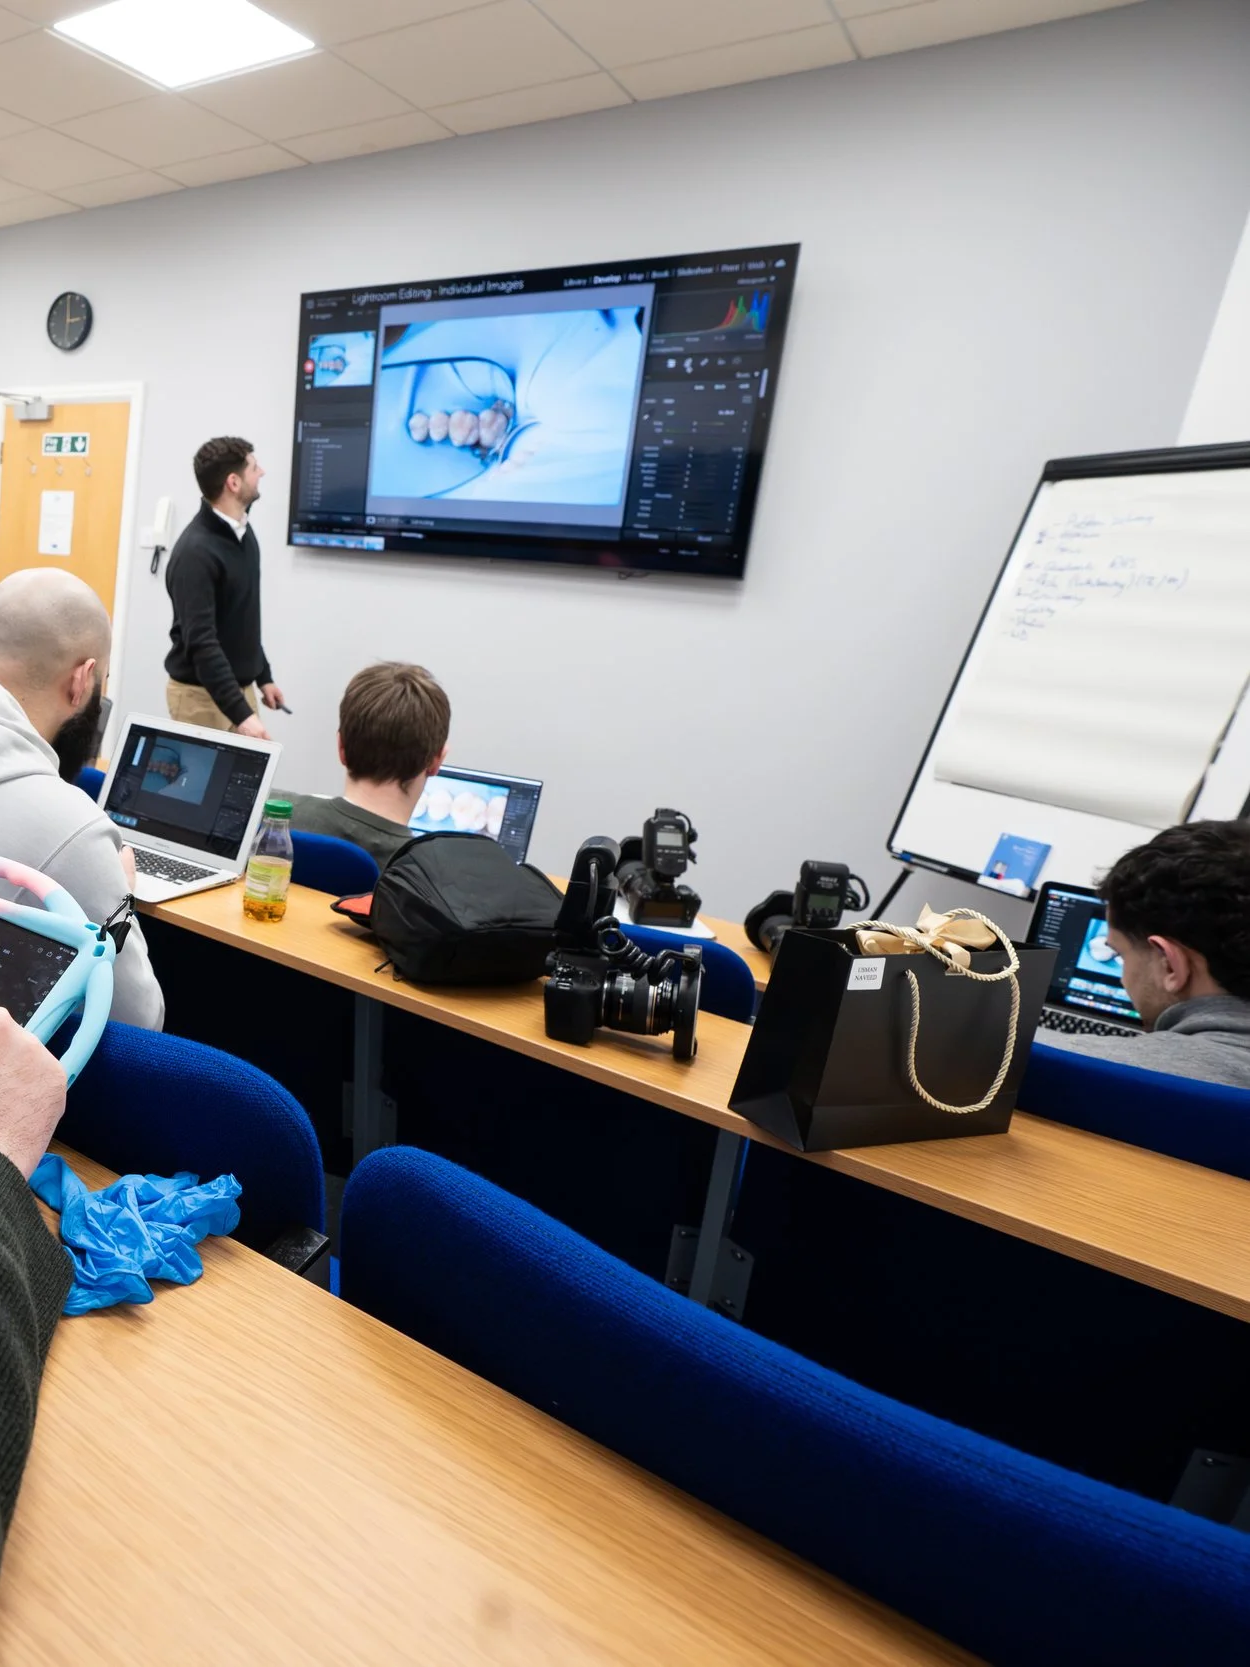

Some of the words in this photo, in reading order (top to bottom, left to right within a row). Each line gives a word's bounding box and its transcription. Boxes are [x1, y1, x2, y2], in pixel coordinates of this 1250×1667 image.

[563, 277, 588, 287] Library
[593, 273, 622, 285] Develop
[651, 268, 670, 278] Book
[677, 266, 713, 277] Slideshow
[352, 291, 397, 305] Lightroom
[399, 287, 431, 300] Editing
[440, 283, 485, 296] Individual
[487, 279, 524, 292] Images
